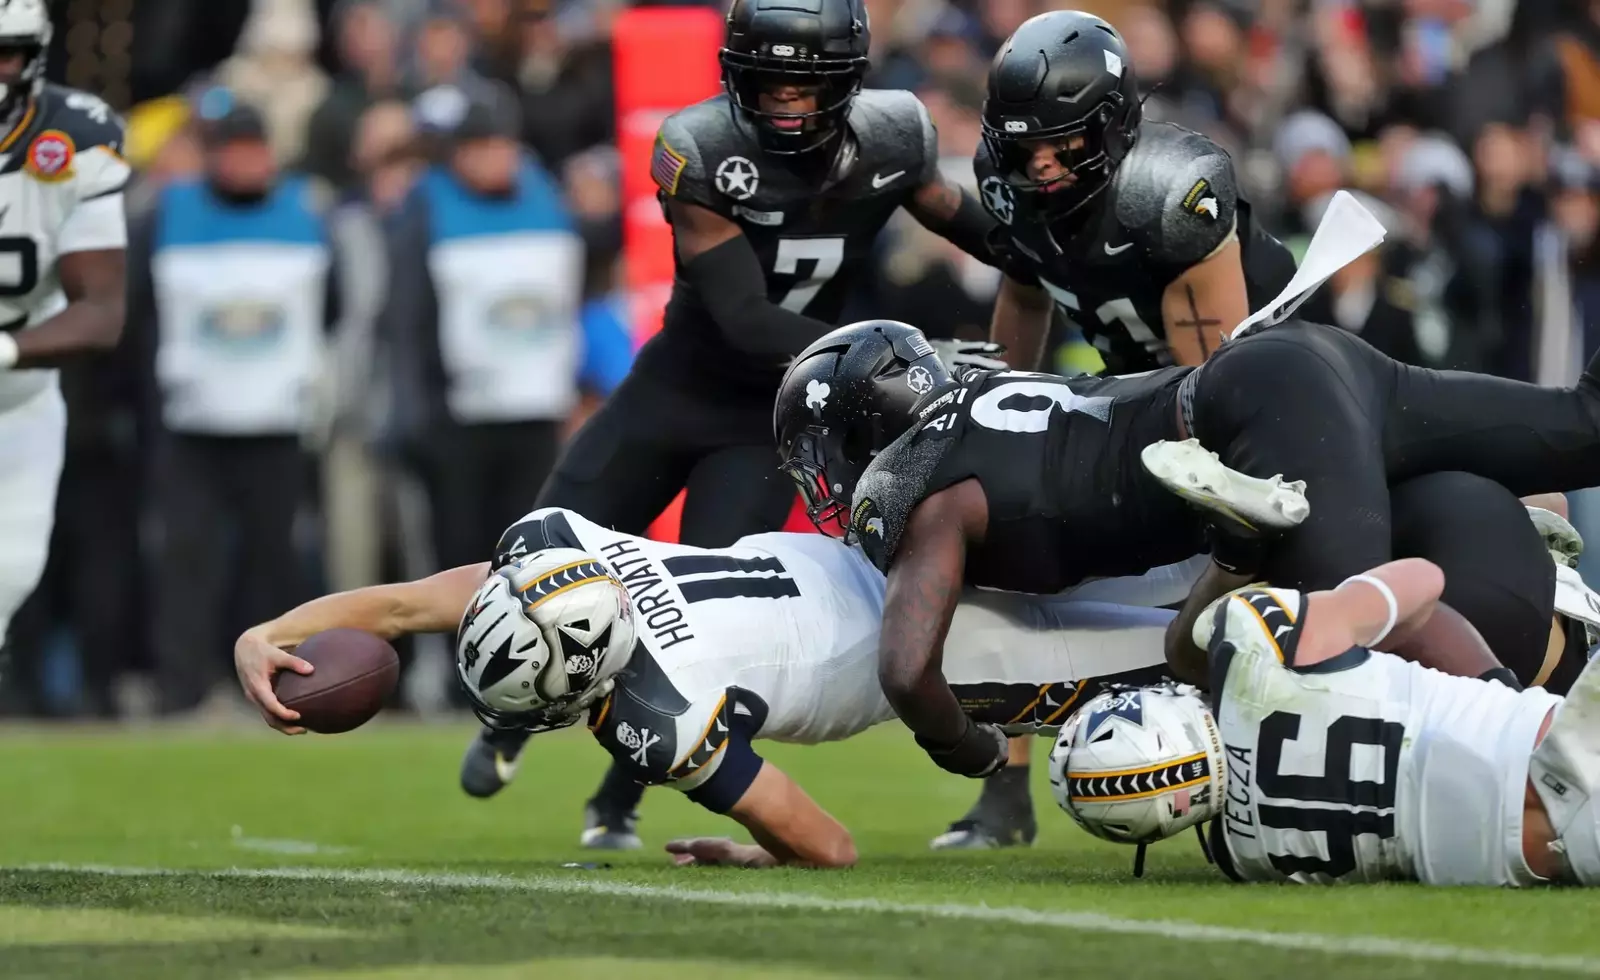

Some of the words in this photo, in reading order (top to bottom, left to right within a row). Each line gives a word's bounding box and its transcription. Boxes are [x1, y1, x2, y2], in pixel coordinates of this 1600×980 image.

[774, 236, 846, 316] 7
[601, 539, 694, 650] HORVATH
[661, 554, 802, 604] 11
[1203, 713, 1220, 753] BONES
[1191, 761, 1203, 777] 46
[1215, 757, 1225, 782] THE
[1225, 743, 1255, 840] TECZA
[1256, 710, 1405, 878] 46
